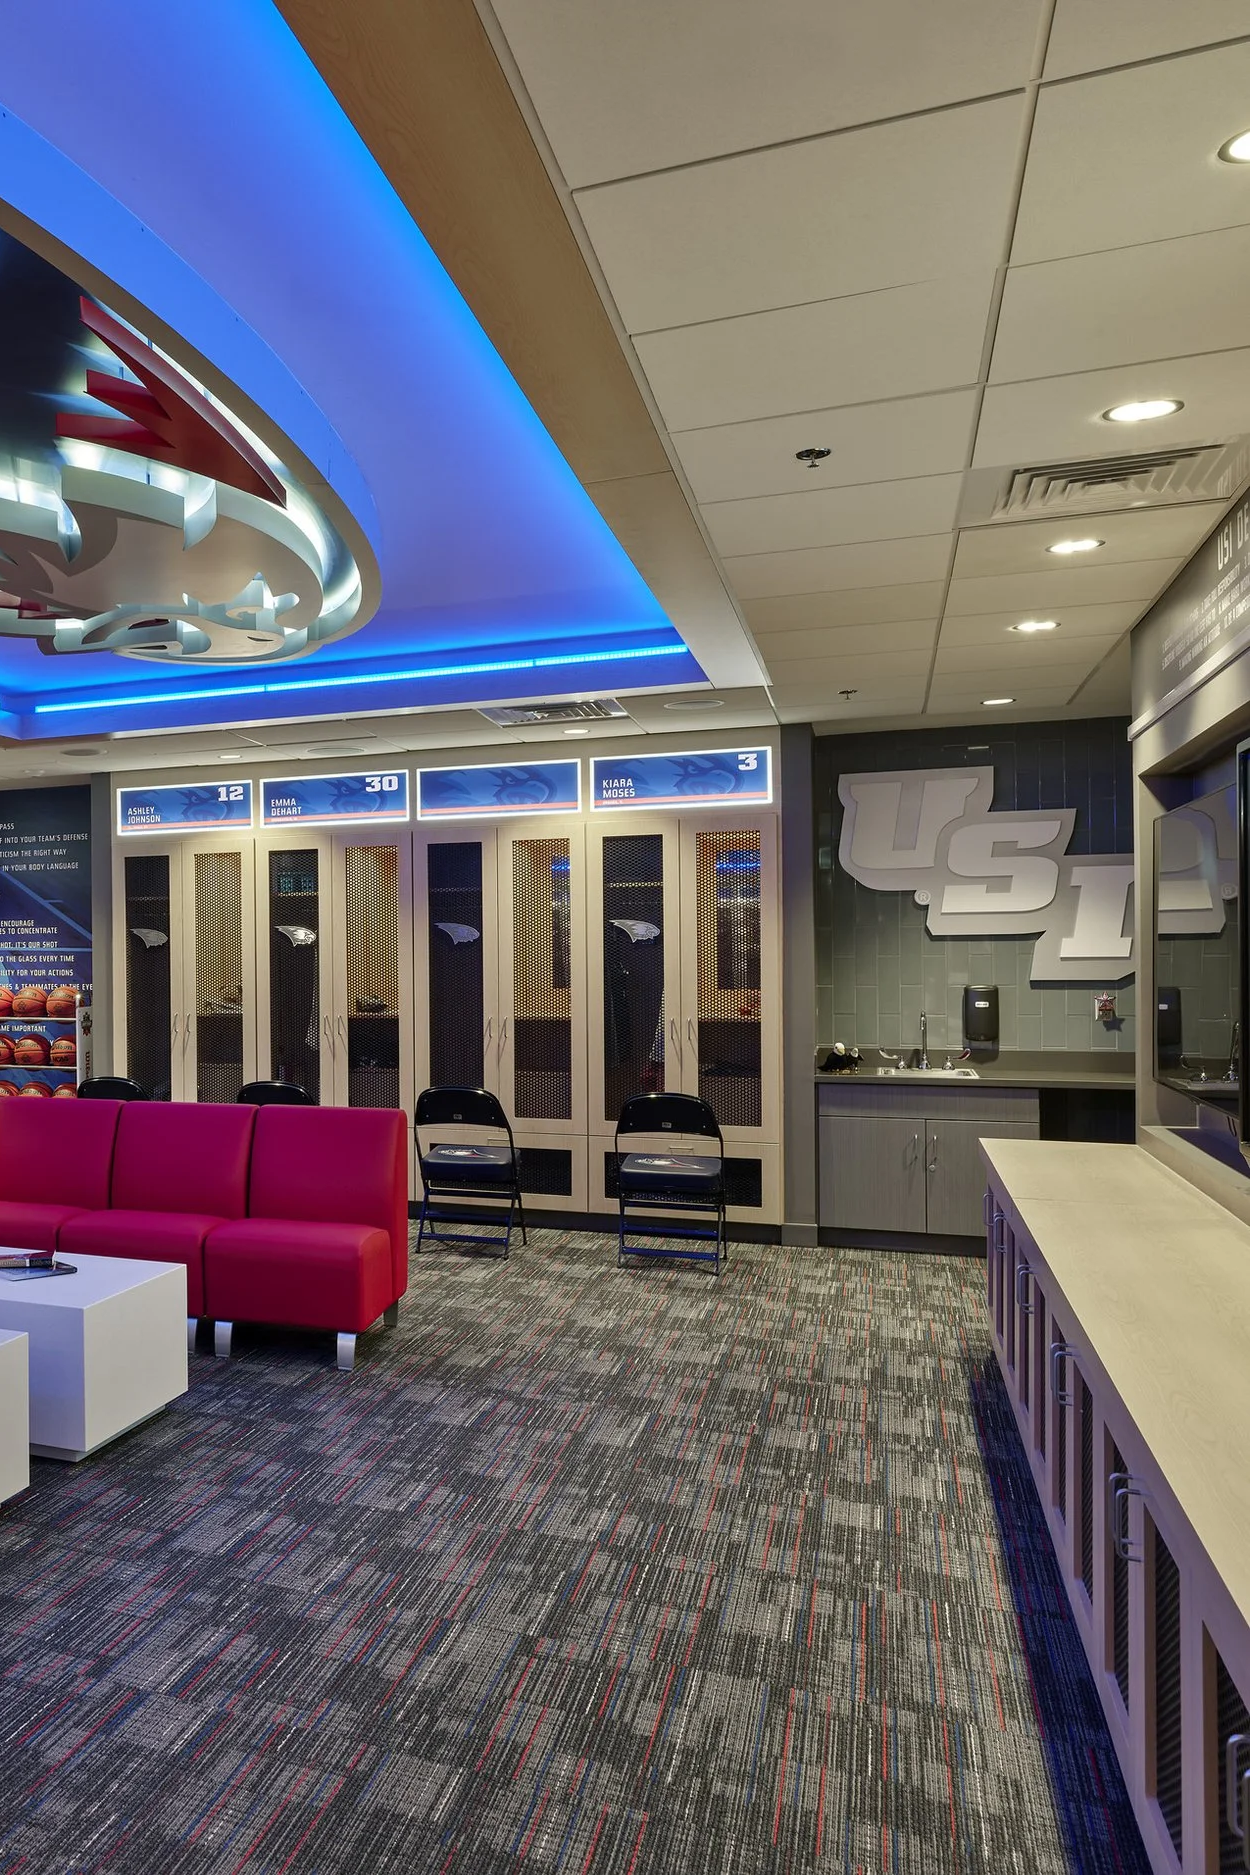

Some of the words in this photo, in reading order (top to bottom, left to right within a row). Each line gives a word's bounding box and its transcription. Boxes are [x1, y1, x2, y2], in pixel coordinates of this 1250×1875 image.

[1218, 521, 1232, 571] USI
[738, 753, 757, 770] 3
[365, 775, 399, 792] 30
[603, 779, 633, 788] KIARA
[217, 786, 244, 801] 12
[603, 789, 635, 798] MOSES
[271, 799, 296, 807] EMMA
[128, 806, 155, 816] ASHLEY
[271, 807, 301, 816] DEHART
[128, 815, 161, 823] JOHNSON
[63, 833, 88, 841] DEFENSE
[29, 863, 44, 871] BODY
[46, 862, 79, 870] LANGUAGE
[849, 777, 1135, 959] USI
